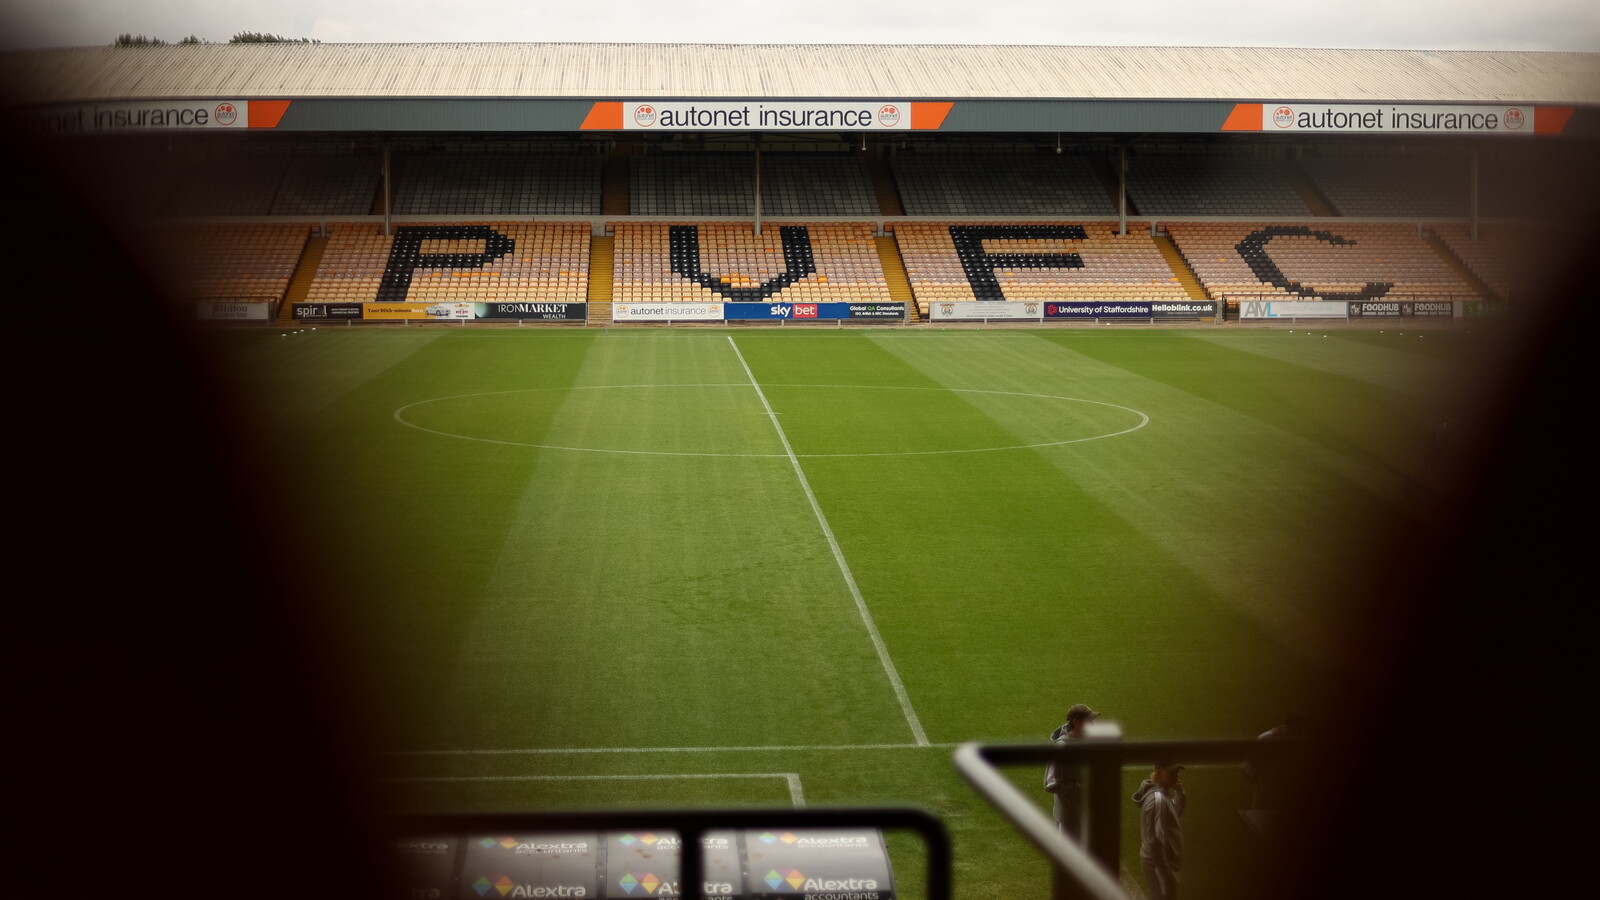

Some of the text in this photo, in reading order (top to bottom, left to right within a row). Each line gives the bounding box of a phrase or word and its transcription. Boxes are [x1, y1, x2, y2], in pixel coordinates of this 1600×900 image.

[94, 104, 209, 129] insurance
[659, 105, 872, 127] autonet insurance
[1297, 108, 1498, 129] autonet insurance
[375, 225, 515, 302] P
[948, 225, 1089, 301] F
[1235, 225, 1395, 300] C
[630, 307, 706, 315] autonet insurance
[770, 304, 815, 317] sky bet
[1058, 306, 1094, 314] University
[1152, 304, 1213, 312] Helloblink.co.uk
[1244, 302, 1278, 317] AML
[516, 842, 588, 850] Alextra
[797, 836, 868, 844] Alextra
[511, 884, 587, 898] Alextra
[804, 878, 878, 891] Alextra
[804, 892, 879, 900] accountants
